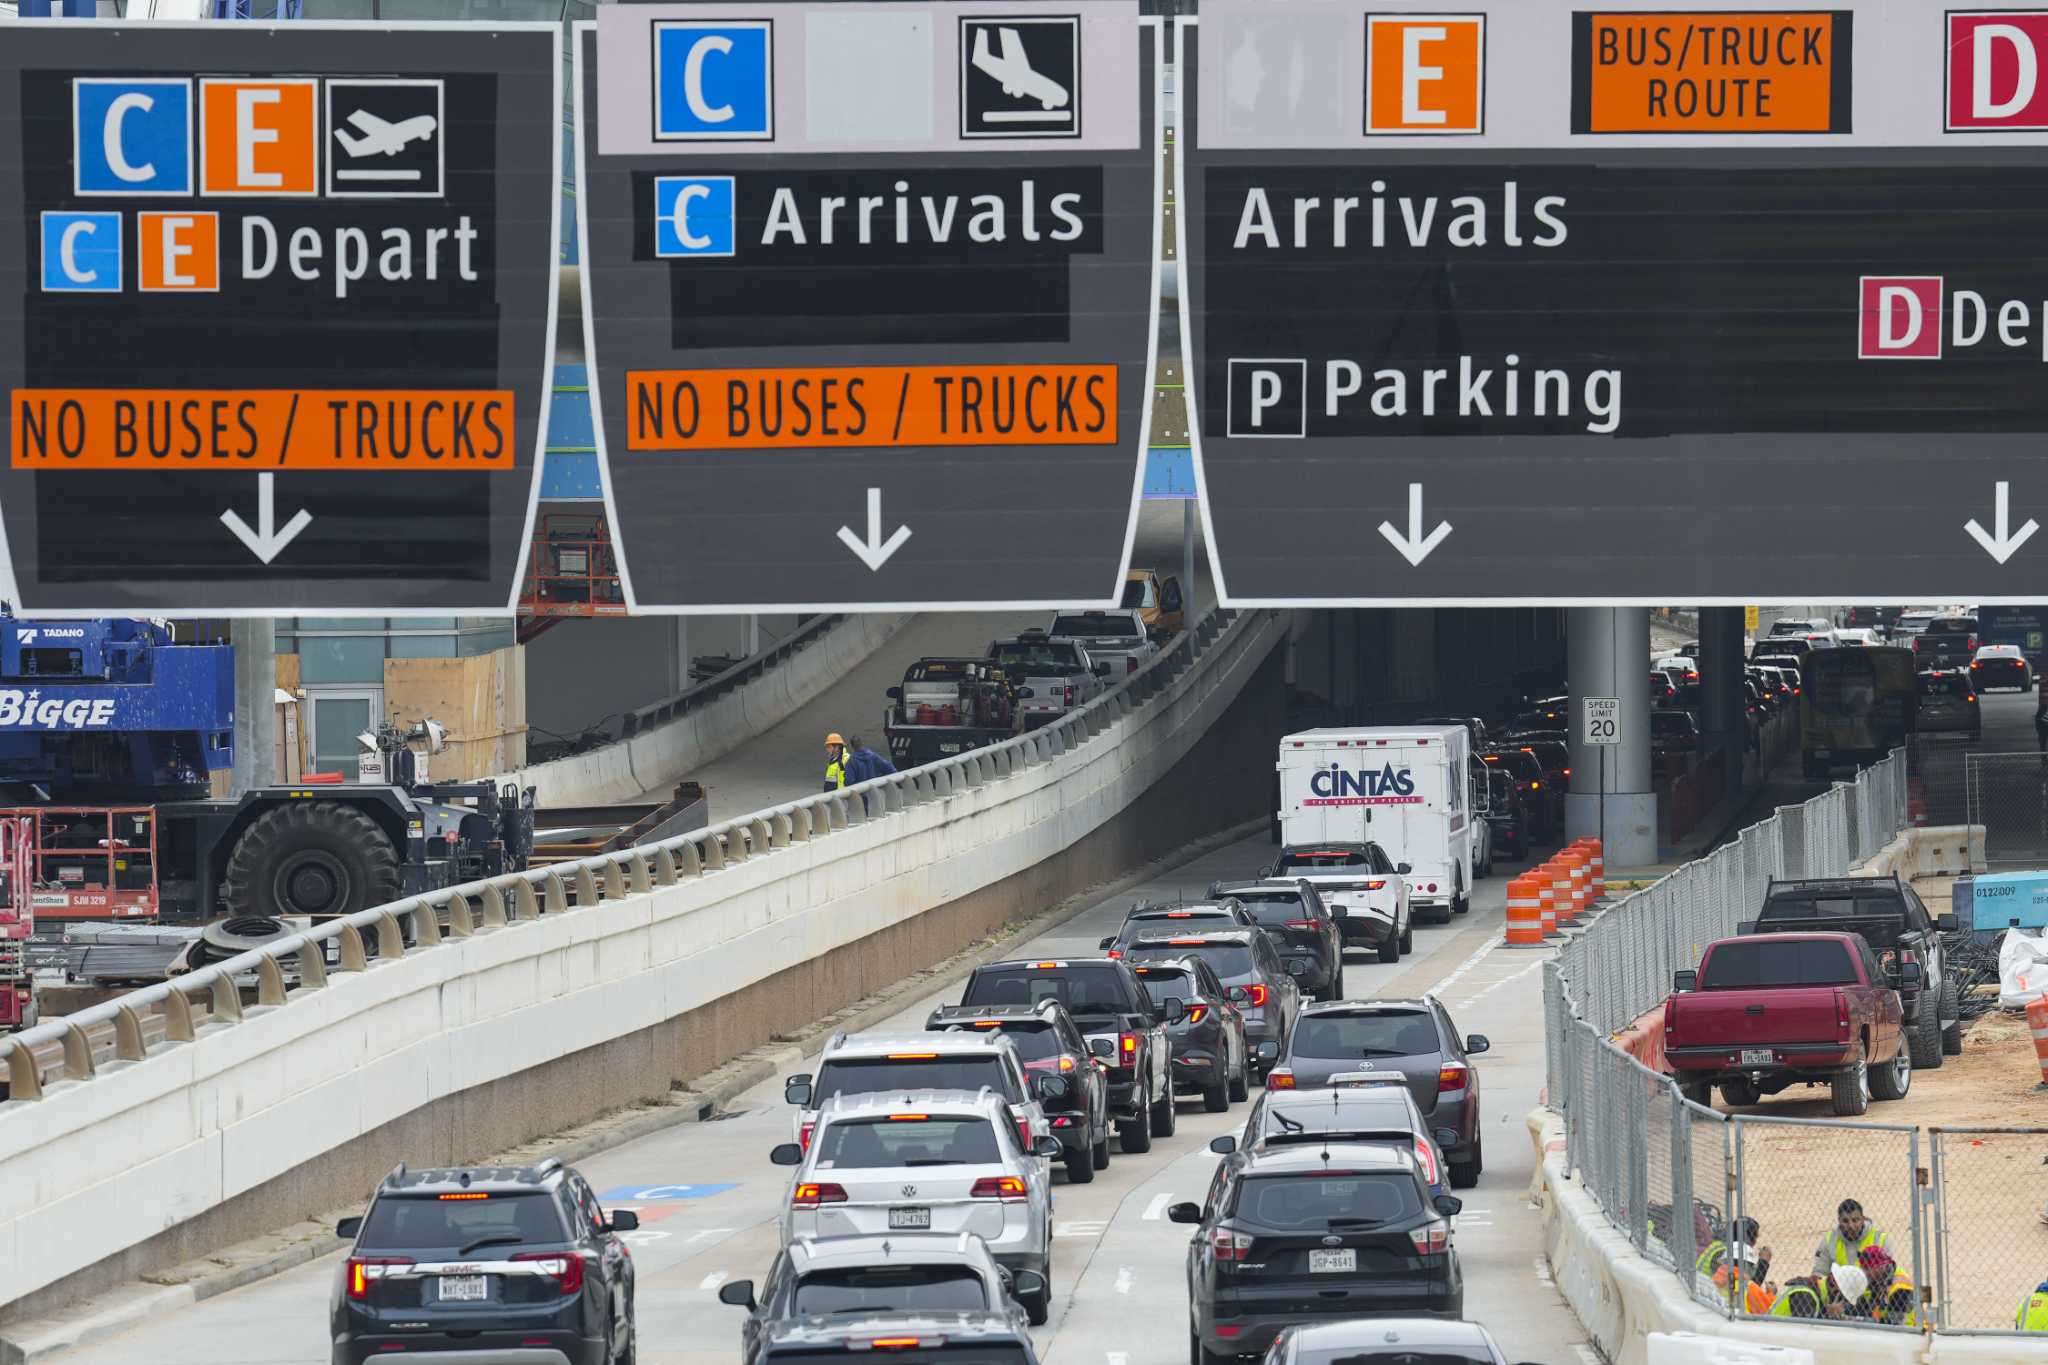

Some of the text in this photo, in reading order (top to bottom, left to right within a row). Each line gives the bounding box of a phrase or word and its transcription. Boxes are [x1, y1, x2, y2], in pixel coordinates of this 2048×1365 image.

[685, 35, 735, 123] C
[1402, 26, 1447, 124] E
[1599, 25, 1823, 71] BUS/TRUCK
[1972, 24, 2037, 118] D
[1647, 79, 1772, 118] ROUTE
[103, 88, 283, 187] C E
[673, 180, 1084, 248] C Arrivals
[1233, 180, 1568, 249] Arrivals
[60, 215, 478, 298] C E Depart
[1879, 286, 2048, 363] D De
[638, 372, 1106, 441] NO BUSES / TRUCKS
[1251, 354, 1622, 434] P Parking
[21, 393, 504, 465] NO BUSES / TRUCKS
[42, 628, 85, 637] TADANO
[1588, 700, 1616, 709] SPEED
[1590, 719, 1615, 737] 20
[1591, 709, 1613, 718] LIMIT
